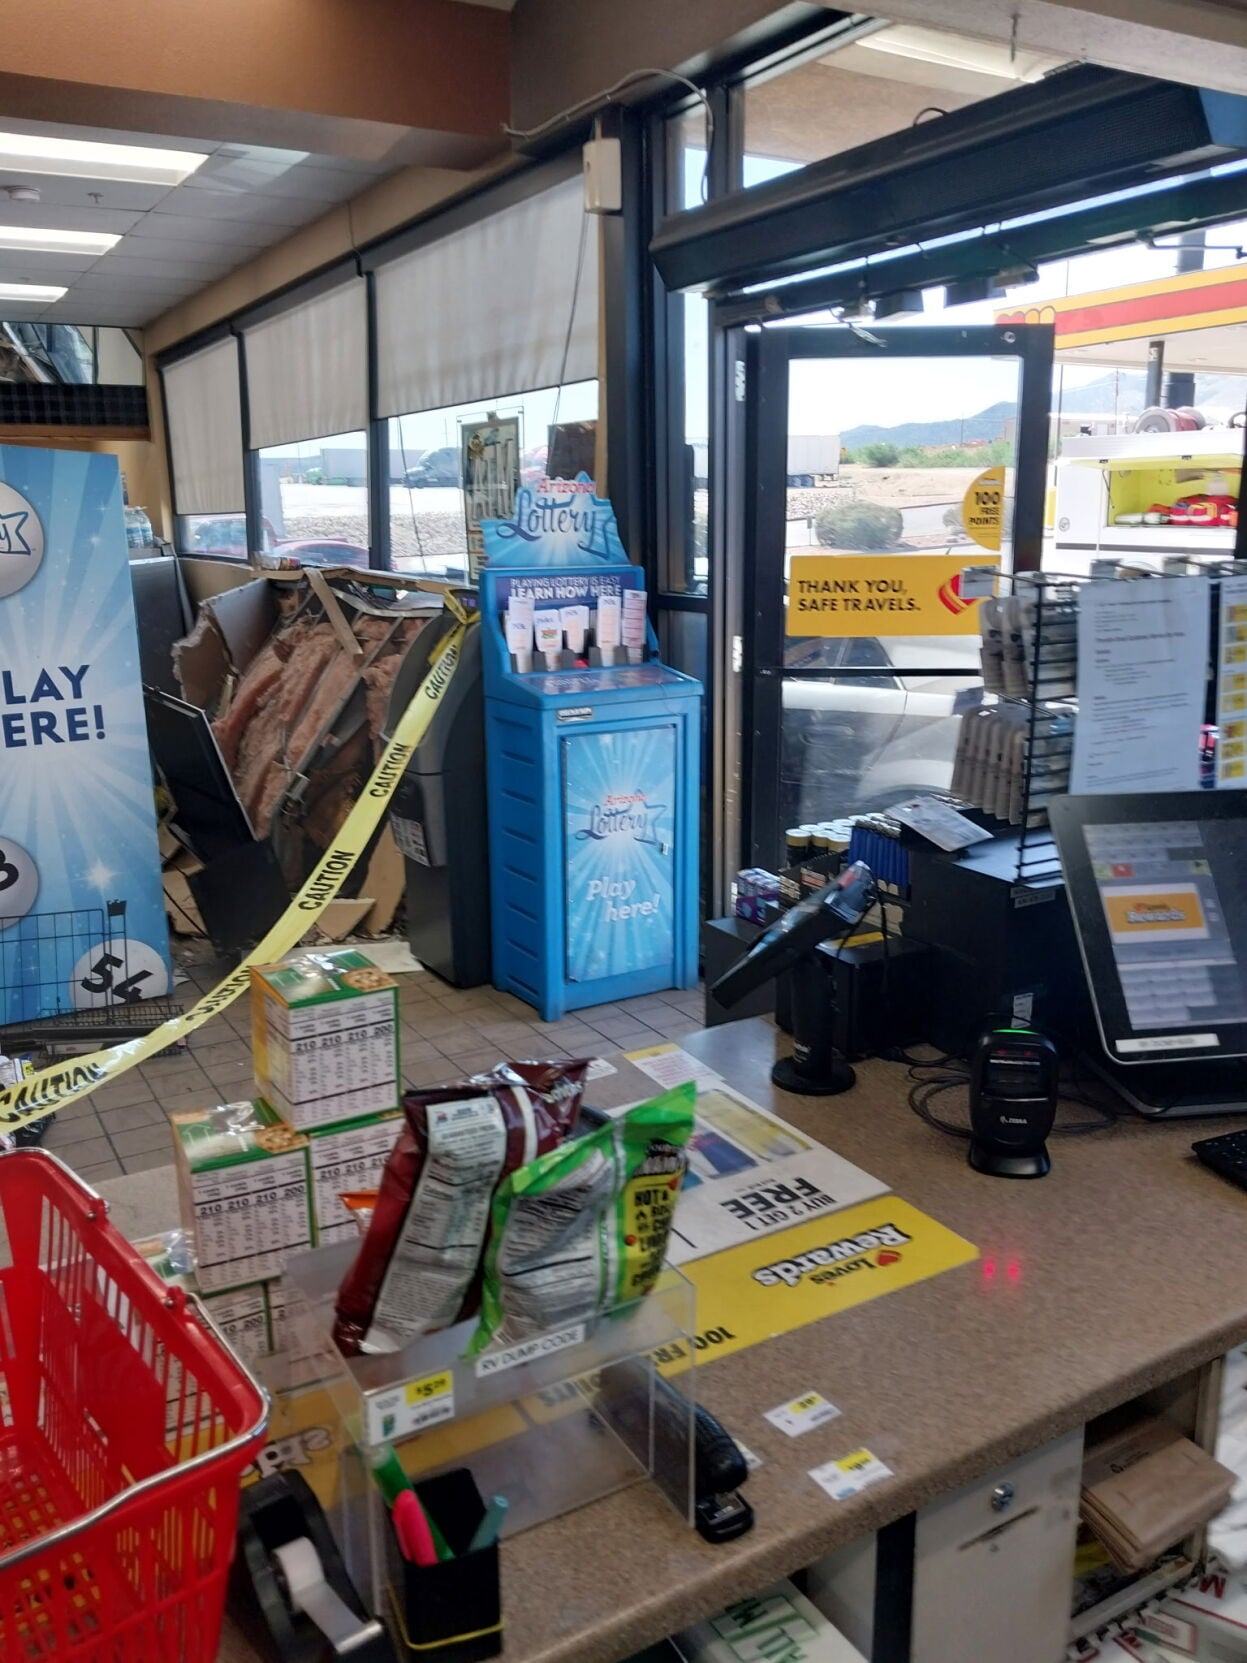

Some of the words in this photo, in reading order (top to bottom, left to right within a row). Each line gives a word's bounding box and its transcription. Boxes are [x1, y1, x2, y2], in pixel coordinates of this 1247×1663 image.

[537, 477, 596, 496] Arizona
[975, 491, 1000, 506] 100
[496, 488, 597, 552] Lottery
[510, 578, 549, 588] PLAYING
[550, 577, 588, 587] LOTTERY
[511, 588, 554, 600] LEARN
[556, 586, 588, 599] HOW
[591, 585, 622, 597] HERE
[798, 579, 859, 594] THANK
[865, 579, 908, 595] YOU,
[798, 597, 839, 612] SAFE
[843, 596, 921, 612] TRAVELS.
[425, 644, 458, 700] CAUTION
[3, 664, 91, 705] LAY
[3, 705, 107, 749] ERE!
[370, 743, 410, 798] CAUTION
[576, 804, 655, 844] Lottery
[298, 850, 355, 911] CAUTION
[586, 877, 636, 901] play
[605, 894, 660, 922] here!
[296, 1041, 317, 1053] 210
[322, 1035, 341, 1048] 210
[348, 1030, 367, 1042] 210
[0, 1062, 107, 1120] CAUTION
[320, 1168, 341, 1180] 210
[345, 1162, 366, 1174] 210
[200, 1204, 222, 1215] 210
[228, 1198, 249, 1210] 210
[256, 1191, 276, 1203] 210
[720, 1176, 822, 1220] FREE
[790, 1204, 801, 1216] 2
[802, 1193, 837, 1214] BUY
[757, 1206, 788, 1229] GET
[751, 1223, 912, 1289] Rewards
[480, 1355, 500, 1373] RV
[502, 1341, 539, 1365] DUMP
[541, 1327, 582, 1353] CODE
[687, 1326, 736, 1351] 100
